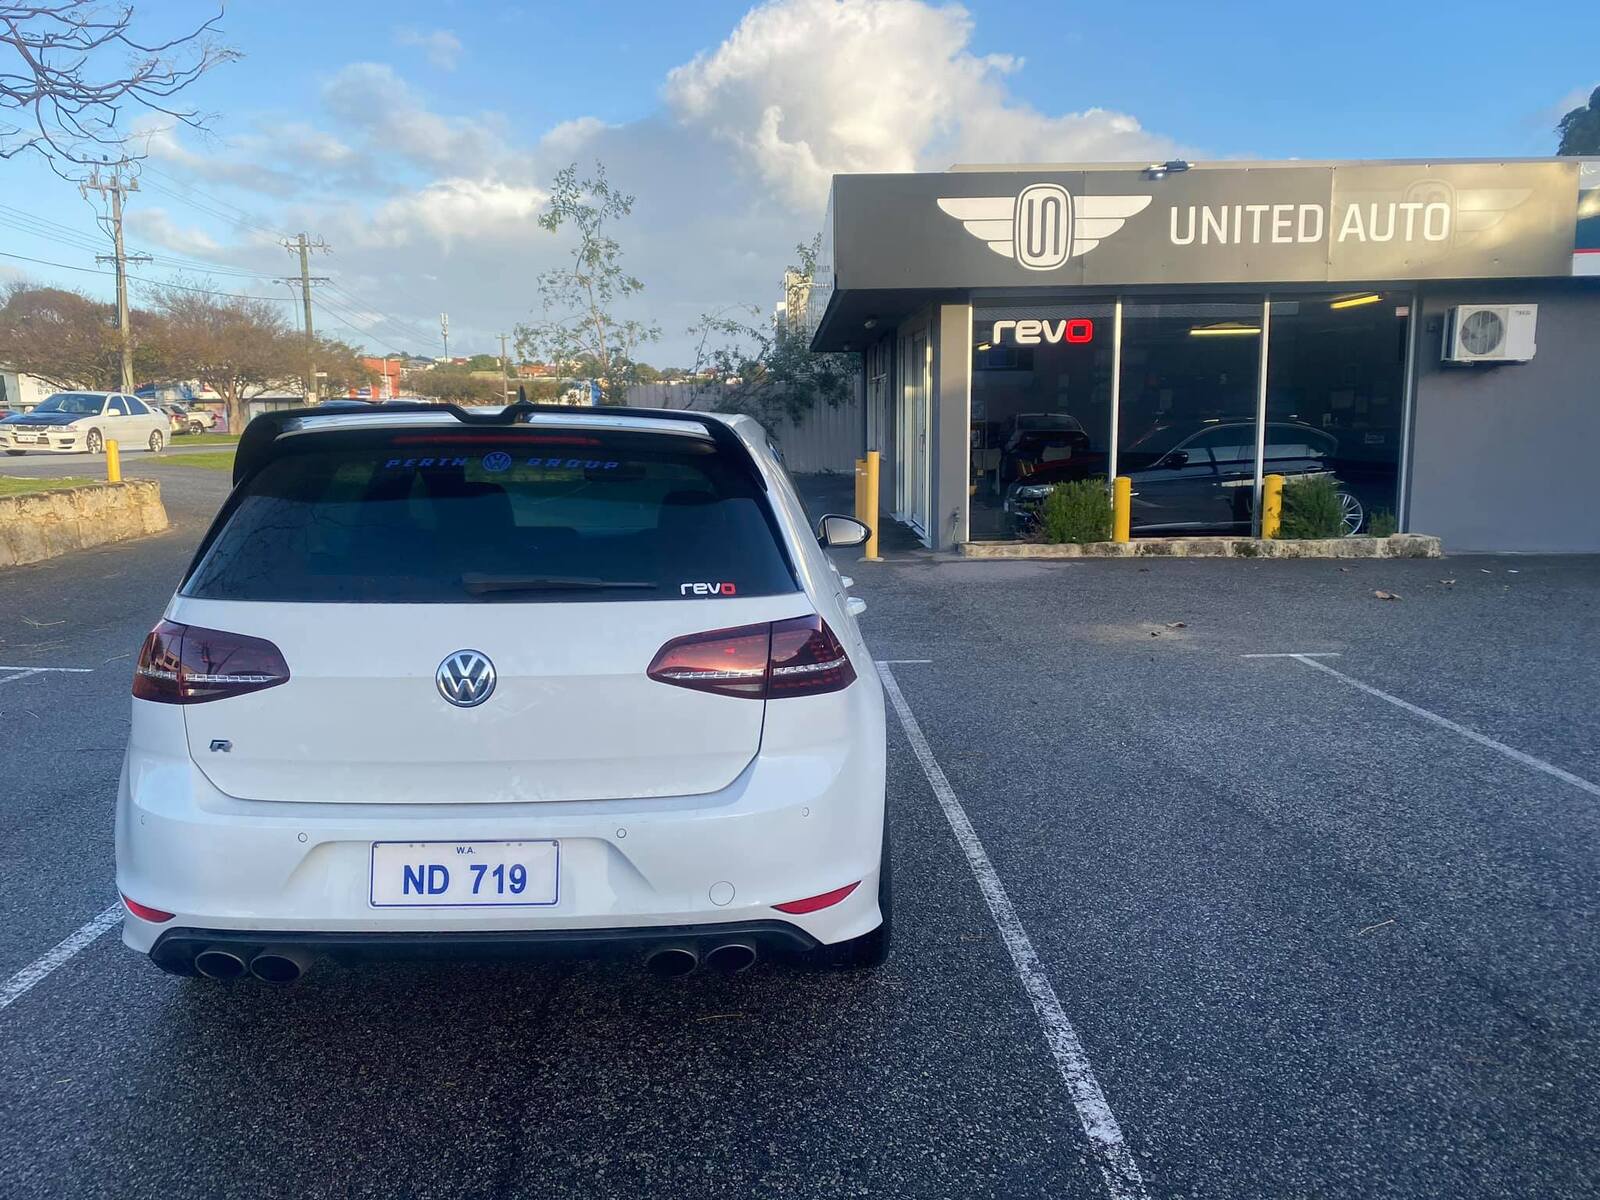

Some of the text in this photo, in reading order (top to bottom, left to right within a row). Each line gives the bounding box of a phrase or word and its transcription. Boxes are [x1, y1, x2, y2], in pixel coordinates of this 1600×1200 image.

[1170, 202, 1451, 245] UNITED AUTO
[993, 319, 1093, 344] revo
[385, 457, 468, 468] PERTH
[527, 457, 619, 469] GROUP
[680, 582, 736, 595] revo
[209, 739, 233, 752] R
[456, 846, 476, 855] W.A.
[403, 864, 527, 895] ND 719
